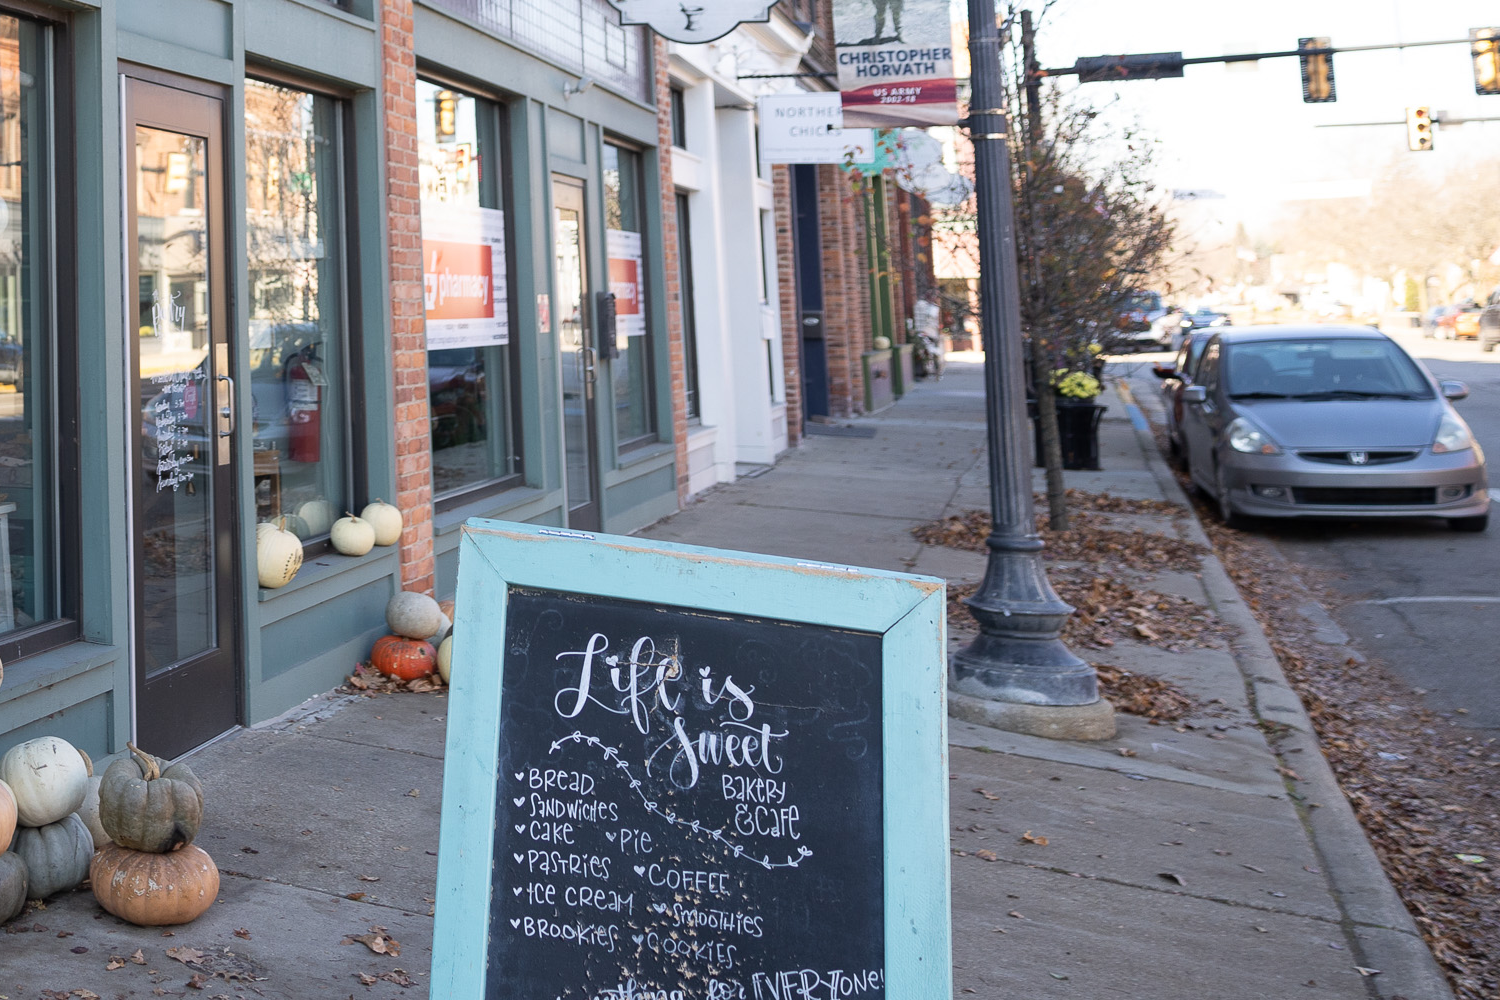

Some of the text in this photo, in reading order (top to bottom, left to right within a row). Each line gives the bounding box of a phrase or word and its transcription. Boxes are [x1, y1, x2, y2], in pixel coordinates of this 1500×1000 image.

[839, 47, 952, 66] CHRISTOPHER
[856, 61, 936, 77] HORVATH
[873, 86, 922, 97] US ARMY
[439, 267, 489, 306] pharmacy
[555, 632, 755, 734] Life is
[646, 716, 789, 790] Sweet
[649, 864, 730, 895] COFFEE
